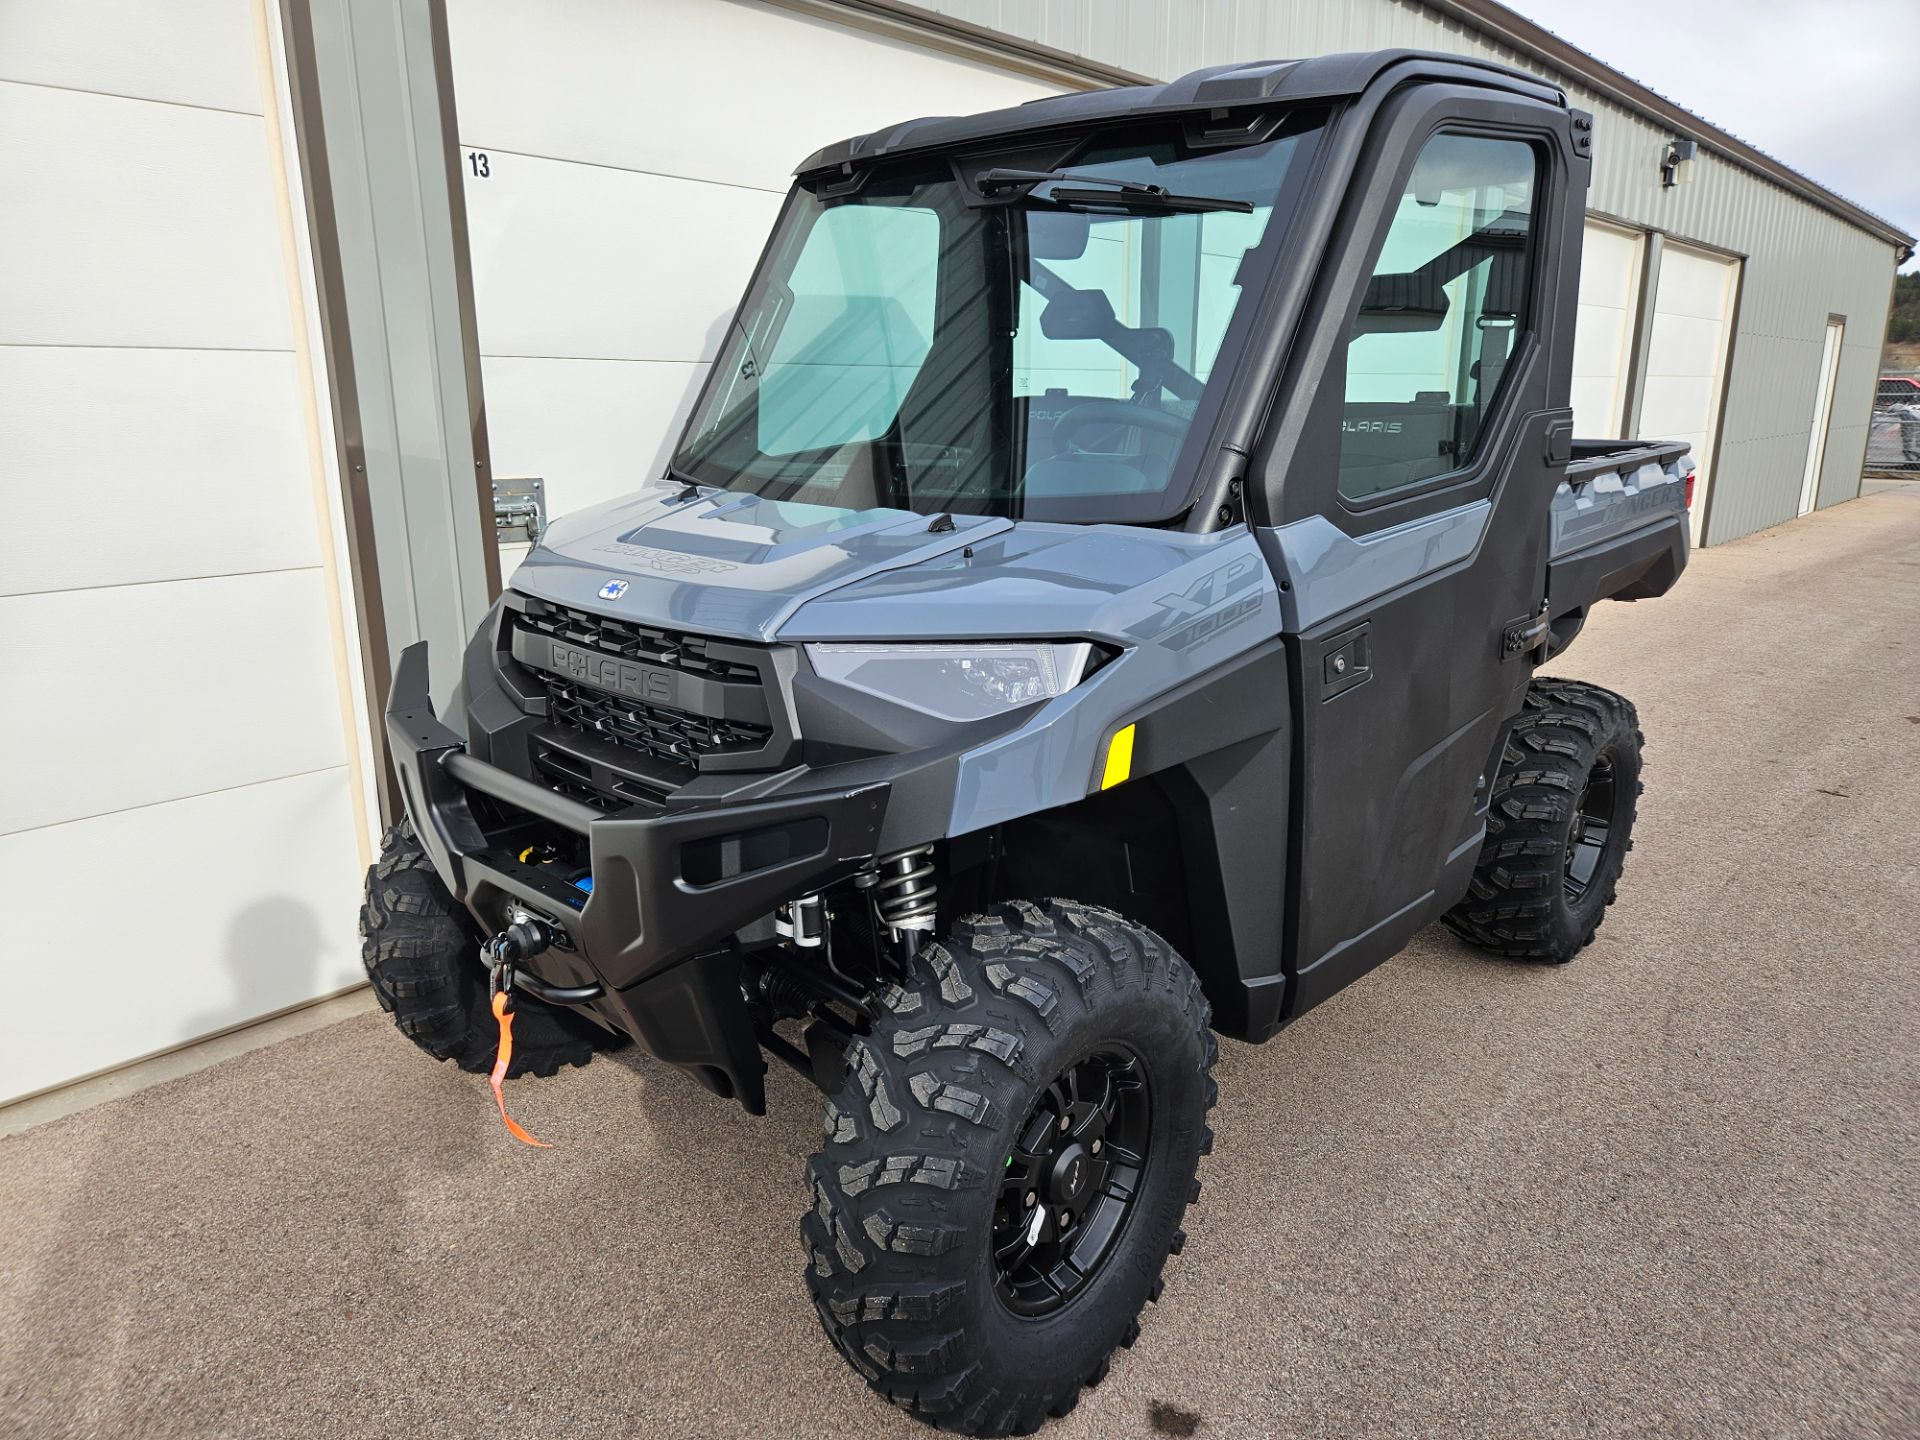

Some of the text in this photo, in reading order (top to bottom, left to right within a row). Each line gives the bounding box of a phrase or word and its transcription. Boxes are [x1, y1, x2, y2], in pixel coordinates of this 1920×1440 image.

[469, 152, 490, 178] 13
[1603, 487, 1672, 521] RANGER
[592, 543, 739, 574] RANGER
[1152, 552, 1261, 628] XP
[1186, 587, 1263, 645] 1000
[551, 644, 673, 700] POLARIS
